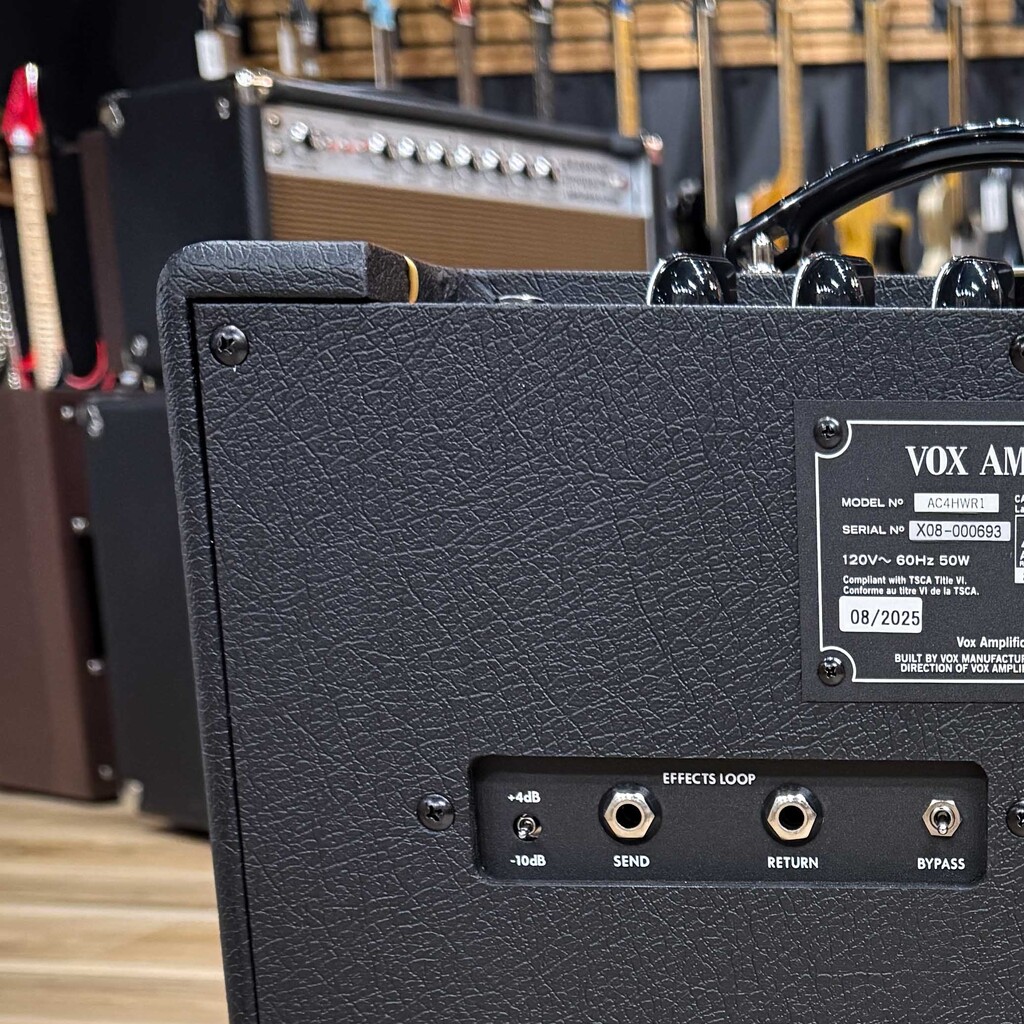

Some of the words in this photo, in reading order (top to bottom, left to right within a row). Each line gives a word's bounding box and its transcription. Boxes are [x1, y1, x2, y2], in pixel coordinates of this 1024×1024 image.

[905, 445, 968, 476] VOX
[842, 498, 885, 508] MODEL
[927, 498, 985, 509] AC4HWR1
[1014, 505, 1024, 514] La
[842, 525, 886, 535] SERIAL
[916, 523, 1002, 538] X08-000693
[896, 555, 934, 566] 60Hz
[939, 555, 970, 566] 50W
[842, 575, 886, 586] Compliant
[888, 576, 906, 584] with
[909, 576, 932, 584] TSCA
[934, 576, 954, 584] Title
[956, 576, 967, 585] VI.
[842, 586, 884, 595] Conforme
[899, 586, 916, 596] titre
[920, 586, 928, 596] VI
[930, 586, 940, 596] de
[944, 586, 950, 596] la
[953, 586, 980, 596] TSCA.
[850, 609, 920, 626] 08/2025
[956, 636, 976, 648] Vox
[894, 654, 922, 662] BUILT
[926, 654, 938, 662] BY
[940, 654, 958, 663] VOX
[900, 664, 952, 673] DIRECTION
[956, 664, 968, 673] OF
[970, 664, 990, 673] VOX
[662, 773, 716, 785] EFFECTS
[720, 773, 756, 785] LOOP
[507, 791, 541, 803] +4dB
[510, 854, 546, 867] -10dB
[614, 855, 650, 868] SEND
[767, 856, 819, 870] RETURN
[917, 857, 966, 872] BYPASS
